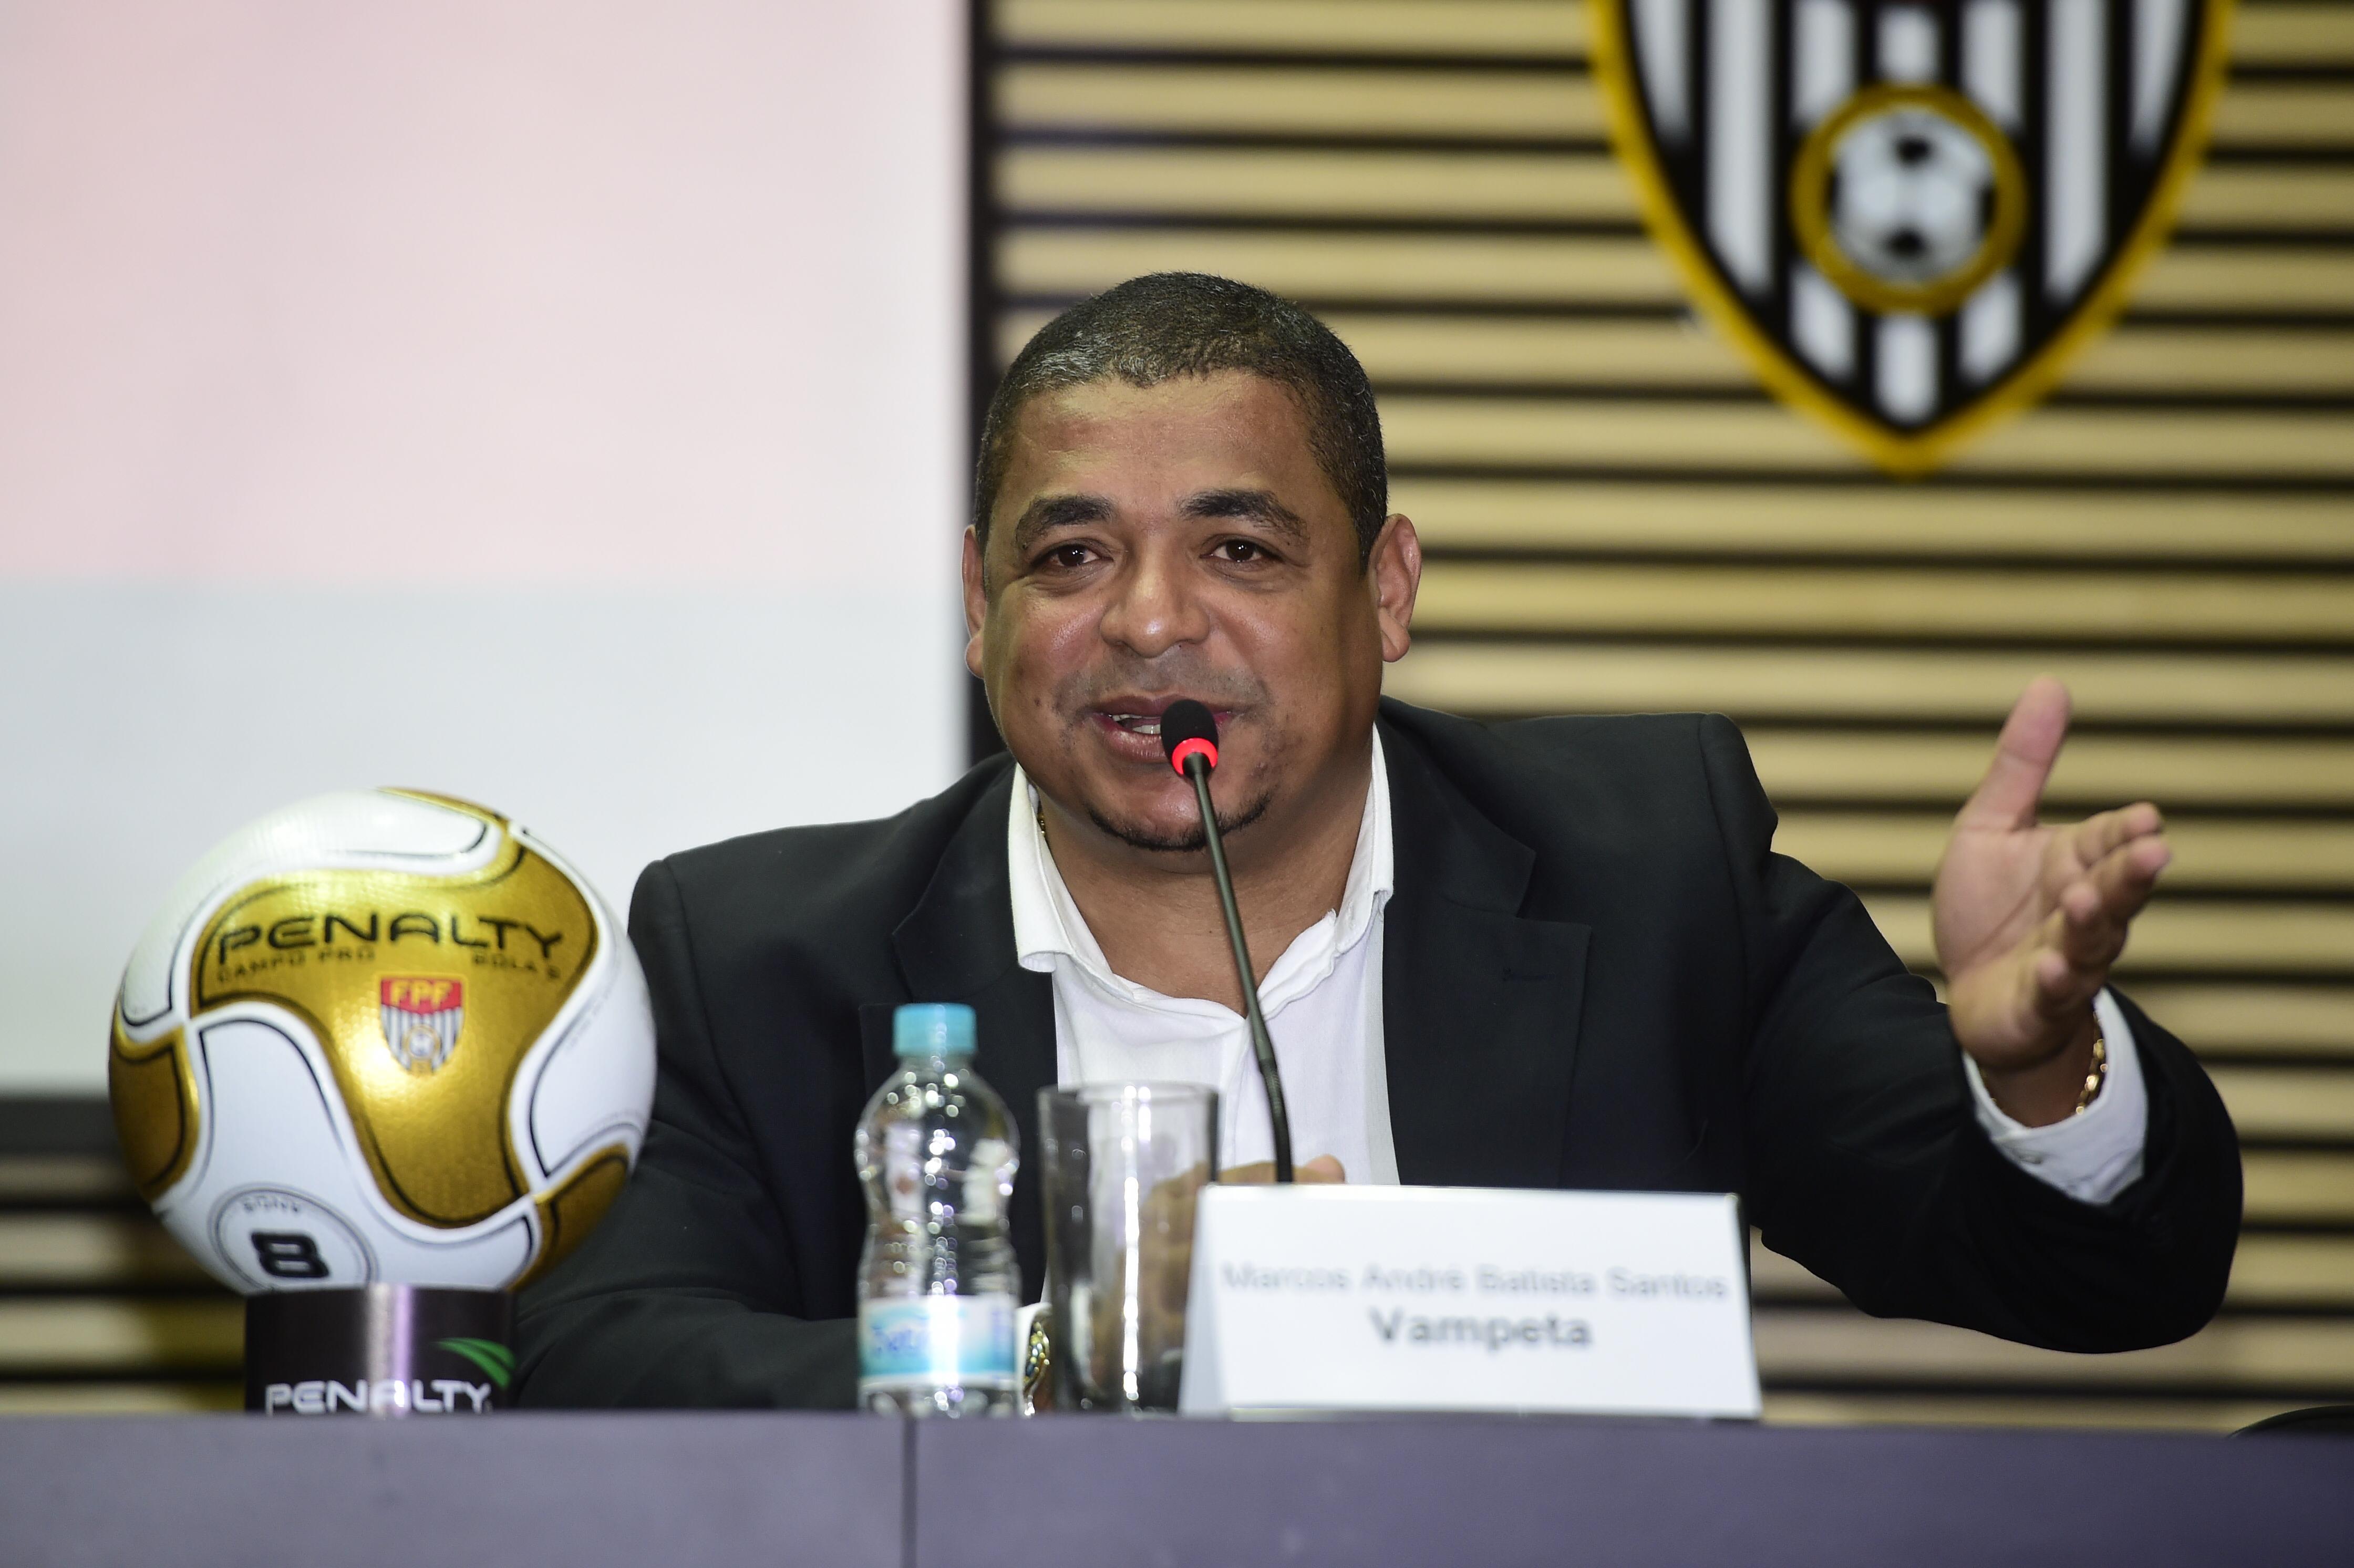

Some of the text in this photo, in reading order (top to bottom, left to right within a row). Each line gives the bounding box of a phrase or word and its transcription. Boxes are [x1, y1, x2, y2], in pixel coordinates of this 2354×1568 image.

[218, 912, 563, 966] PENALTY
[390, 979, 452, 1009] FPF
[250, 1231, 331, 1278] 8
[1606, 1266, 1729, 1299] Santos
[1367, 1306, 1594, 1353] Vampeta
[265, 1379, 491, 1417] PENALTY
